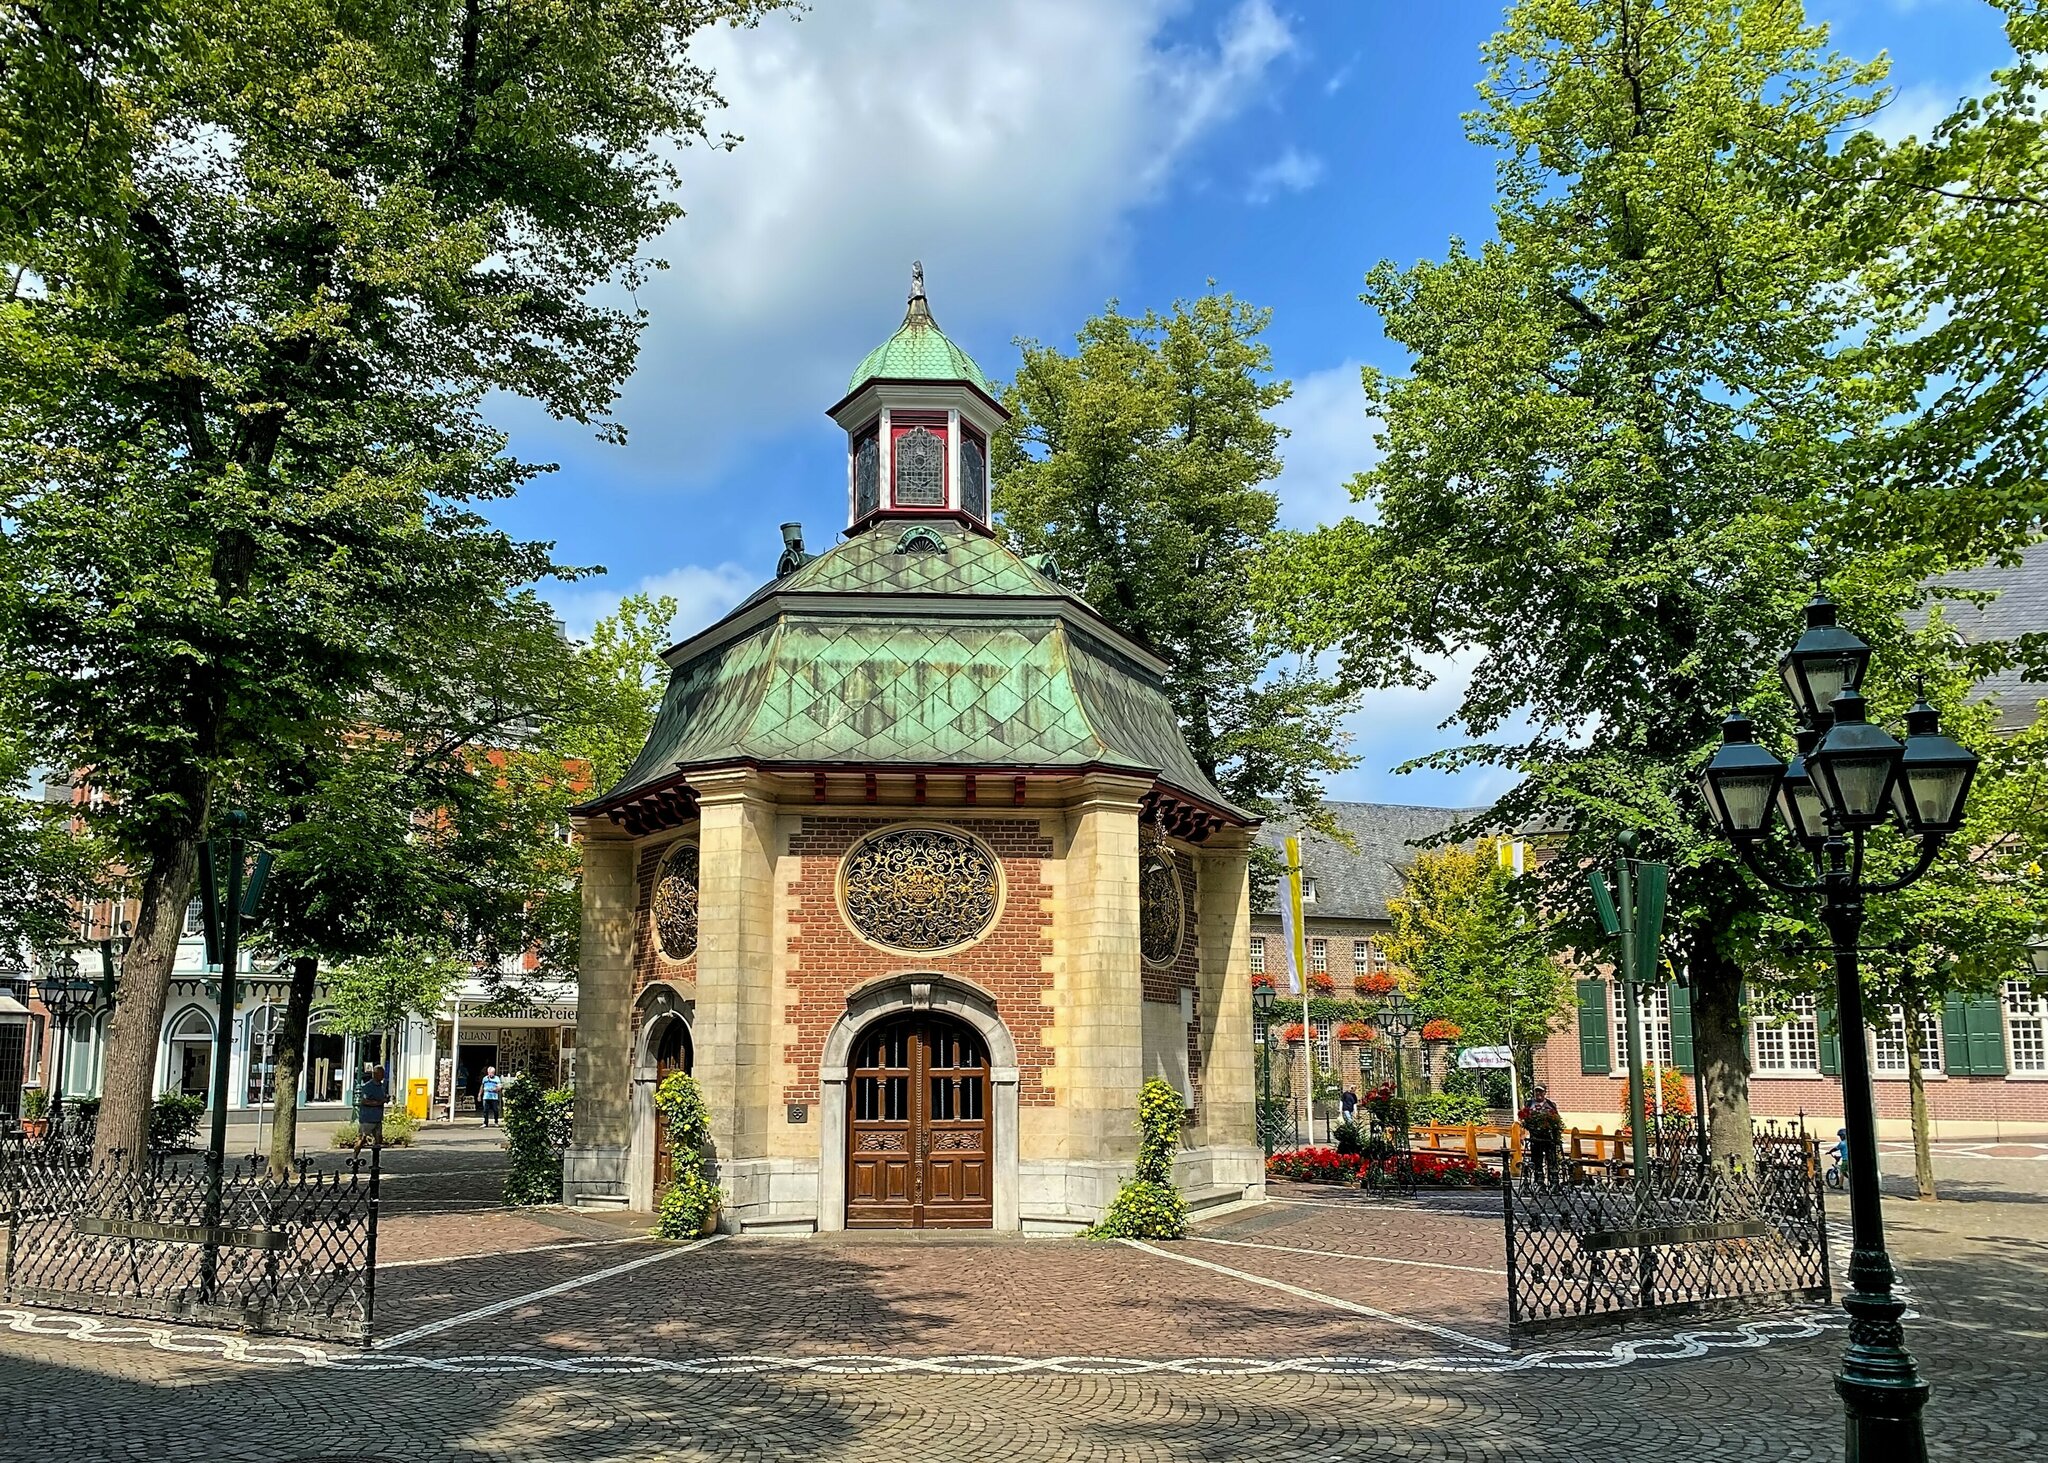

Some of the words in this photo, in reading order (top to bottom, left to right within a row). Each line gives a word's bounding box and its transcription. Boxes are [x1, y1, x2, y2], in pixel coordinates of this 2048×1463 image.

[111, 1223, 165, 1237] REGINA
[174, 1225, 248, 1243] FAMILIAE
[1616, 1232, 1641, 1246] AVE
